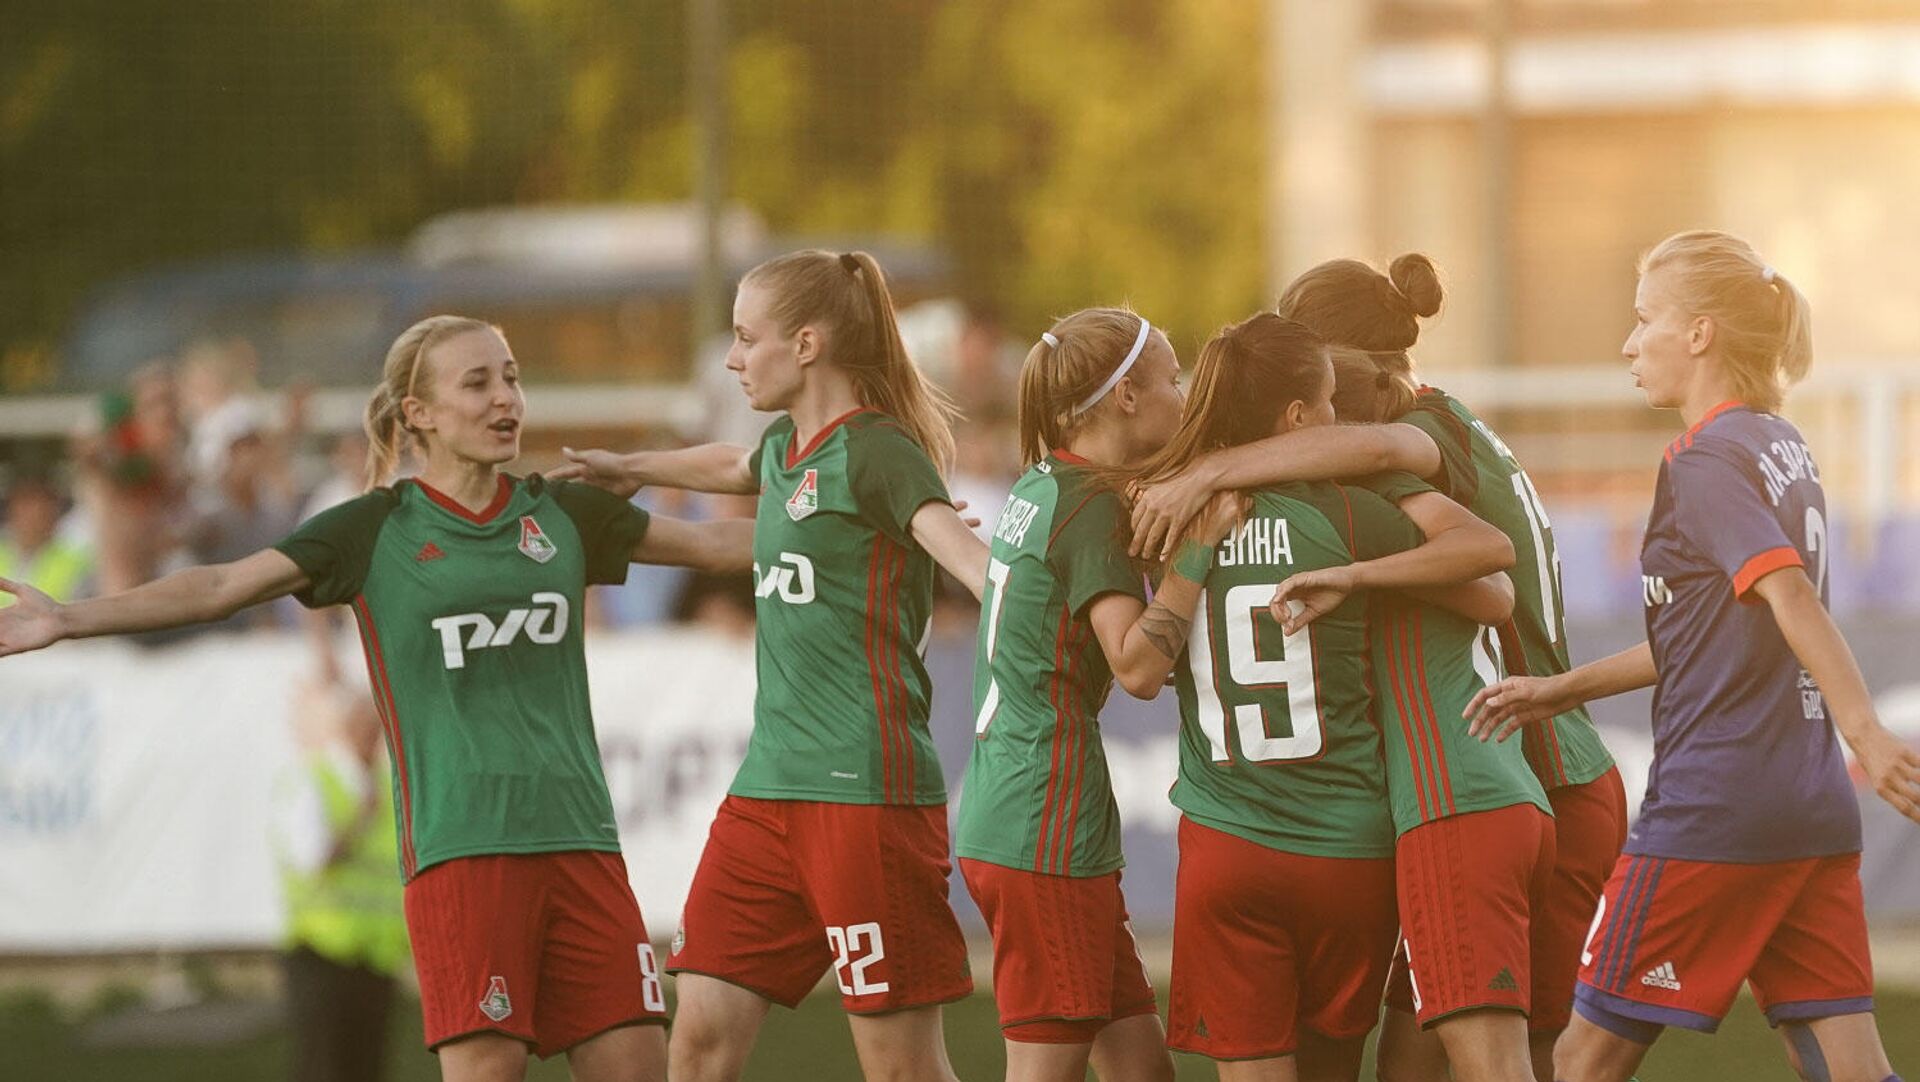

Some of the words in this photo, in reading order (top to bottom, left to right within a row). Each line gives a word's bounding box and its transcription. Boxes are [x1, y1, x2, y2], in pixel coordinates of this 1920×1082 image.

[1217, 517, 1294, 567] ЗИНА
[975, 556, 1010, 734] 7
[1186, 583, 1323, 762] 19
[637, 943, 667, 1013] 8
[825, 922, 890, 996] 22
[1641, 975, 1682, 991] adidas
